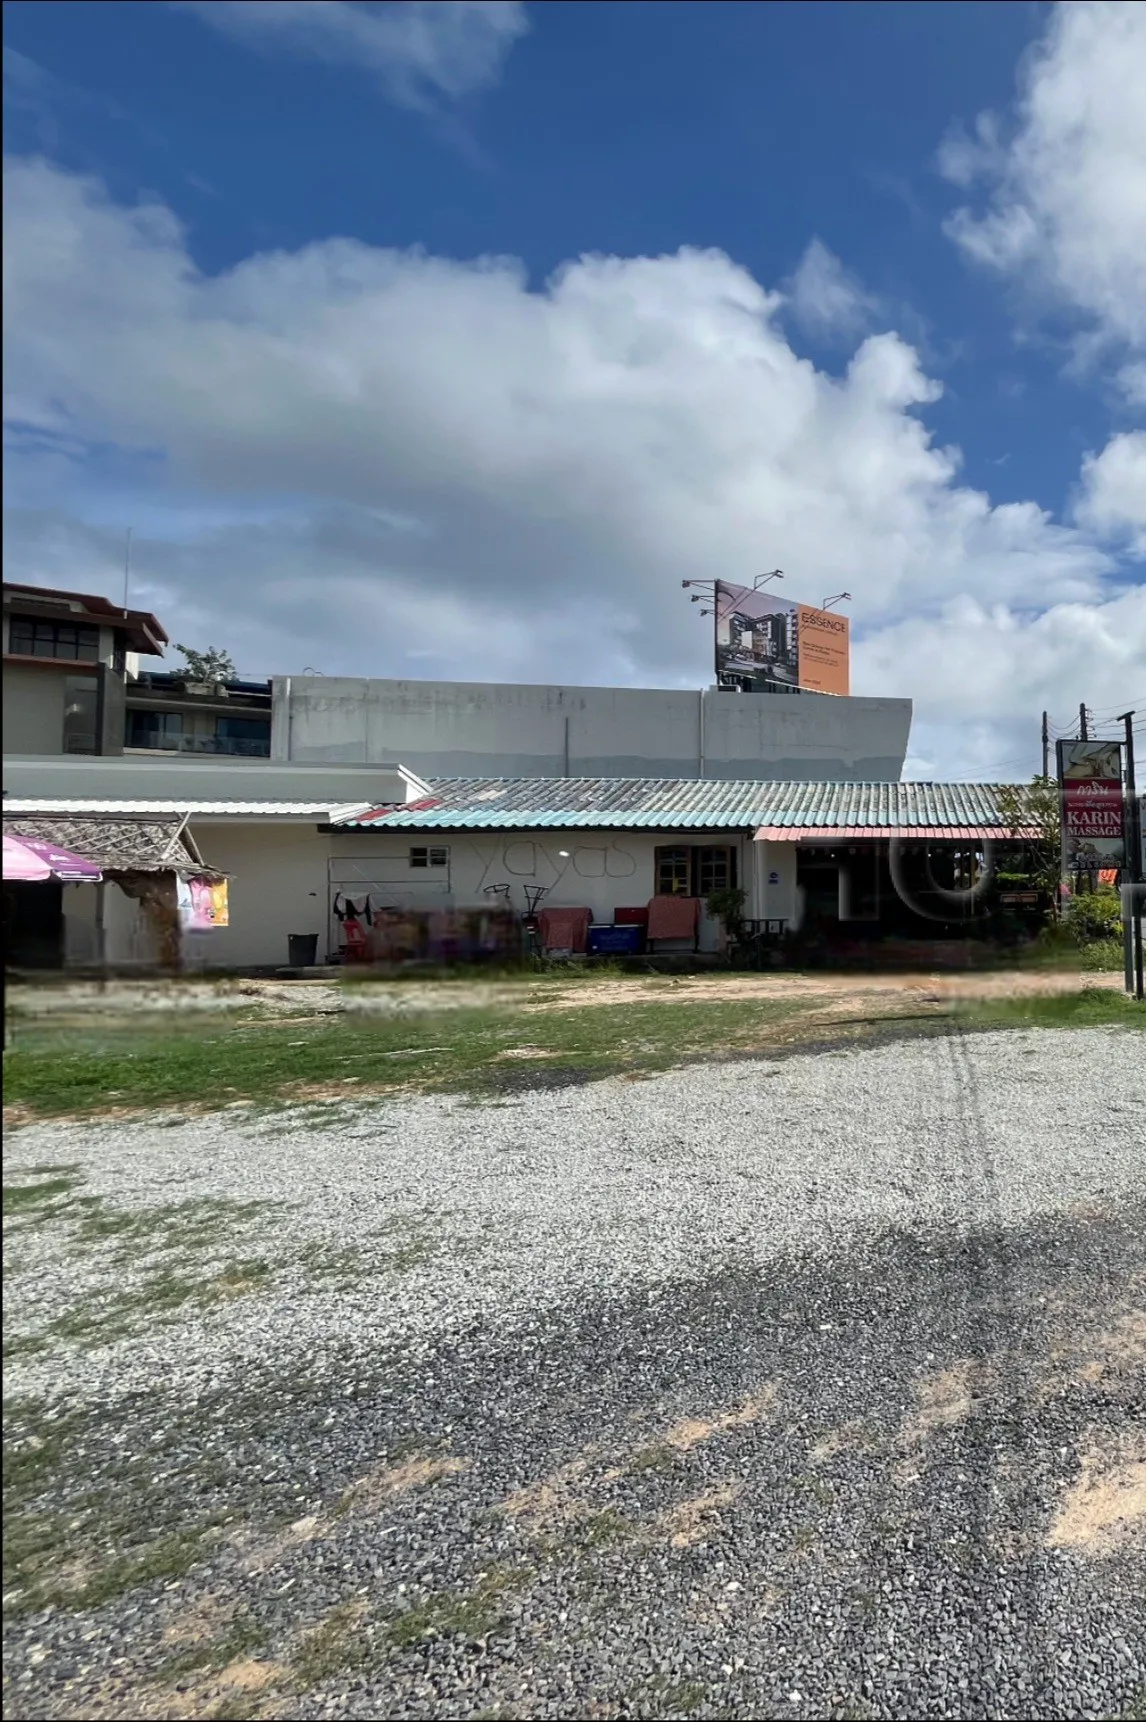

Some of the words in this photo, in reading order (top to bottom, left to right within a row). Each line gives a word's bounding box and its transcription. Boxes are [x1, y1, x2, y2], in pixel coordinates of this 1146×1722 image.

[802, 613, 846, 633] ESSENCE
[1067, 811, 1122, 825] KARIN
[1067, 826, 1121, 836] MASSAGE
